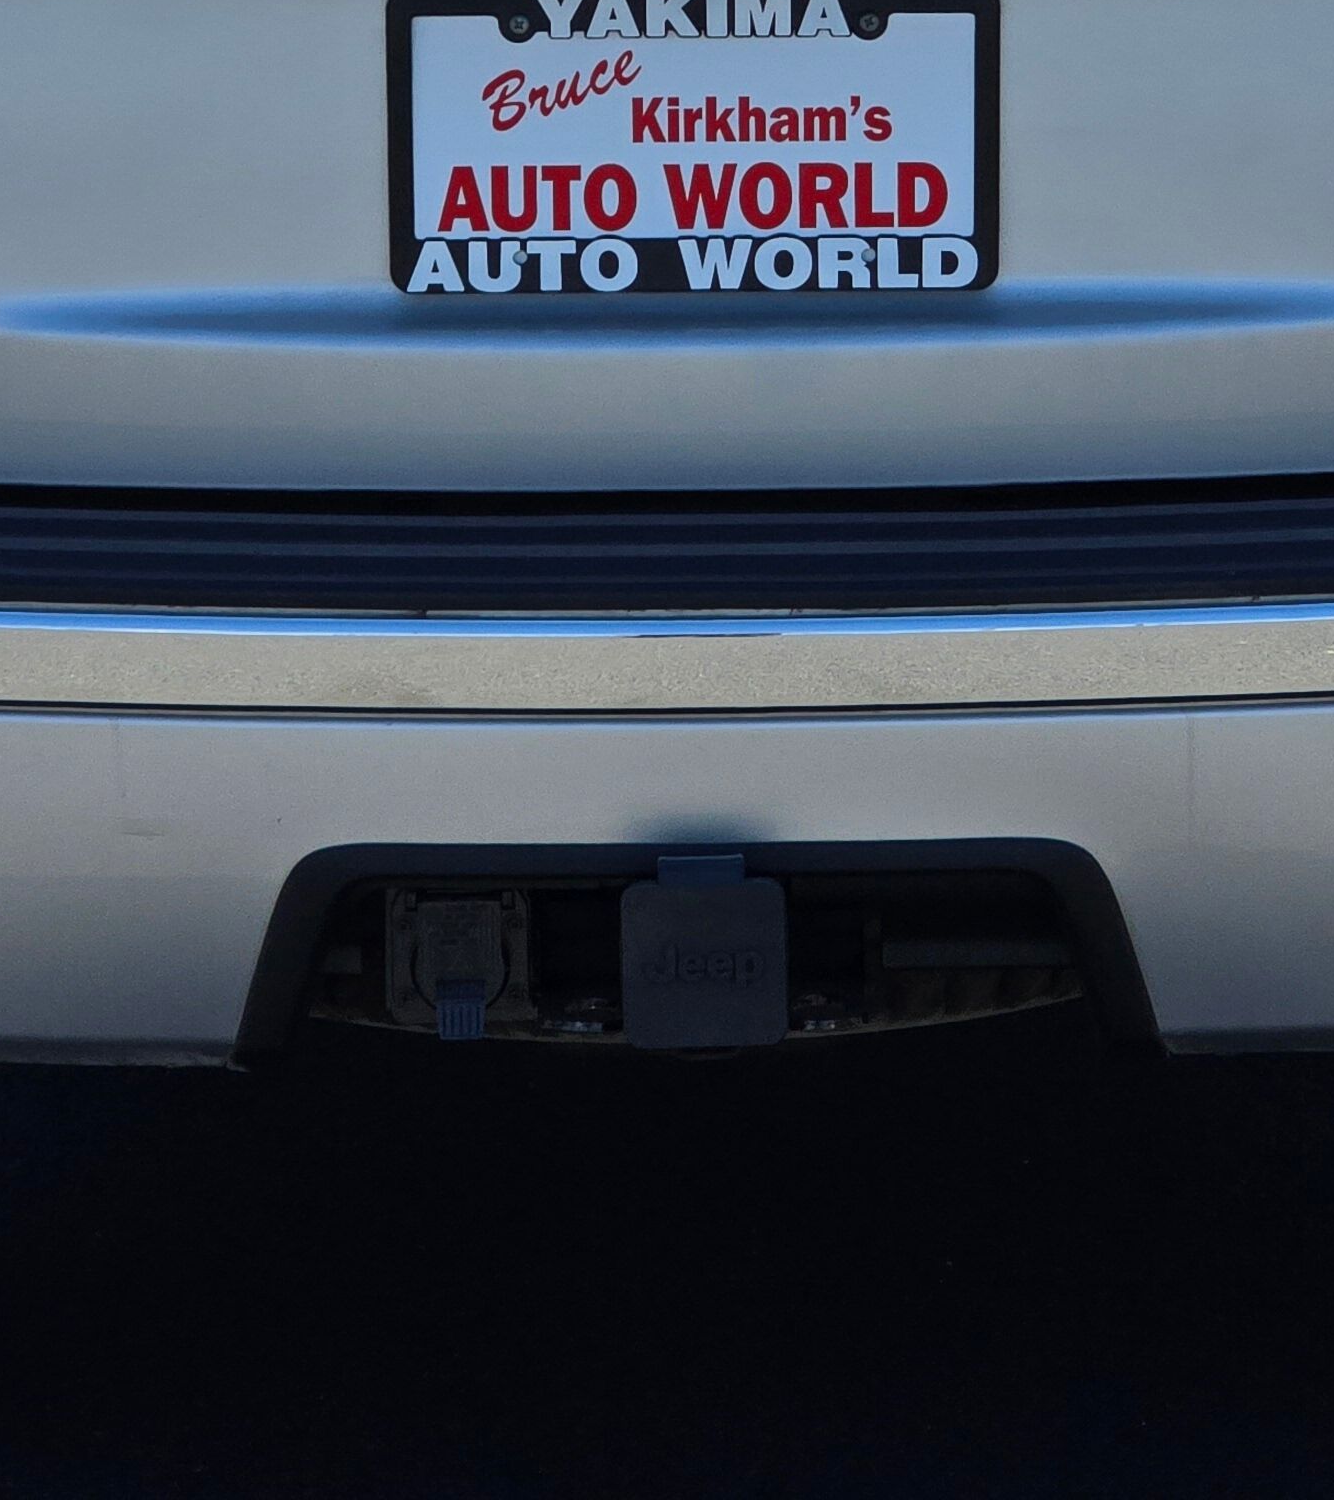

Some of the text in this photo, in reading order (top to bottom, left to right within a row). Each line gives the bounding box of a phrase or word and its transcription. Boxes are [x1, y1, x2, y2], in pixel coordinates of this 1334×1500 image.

[482, 50, 642, 132] Bruce
[631, 95, 893, 144] Kirkham's
[437, 161, 949, 232] AUTO WORLD
[406, 236, 979, 293] AUTO WORLD
[639, 941, 767, 988] Jeep
